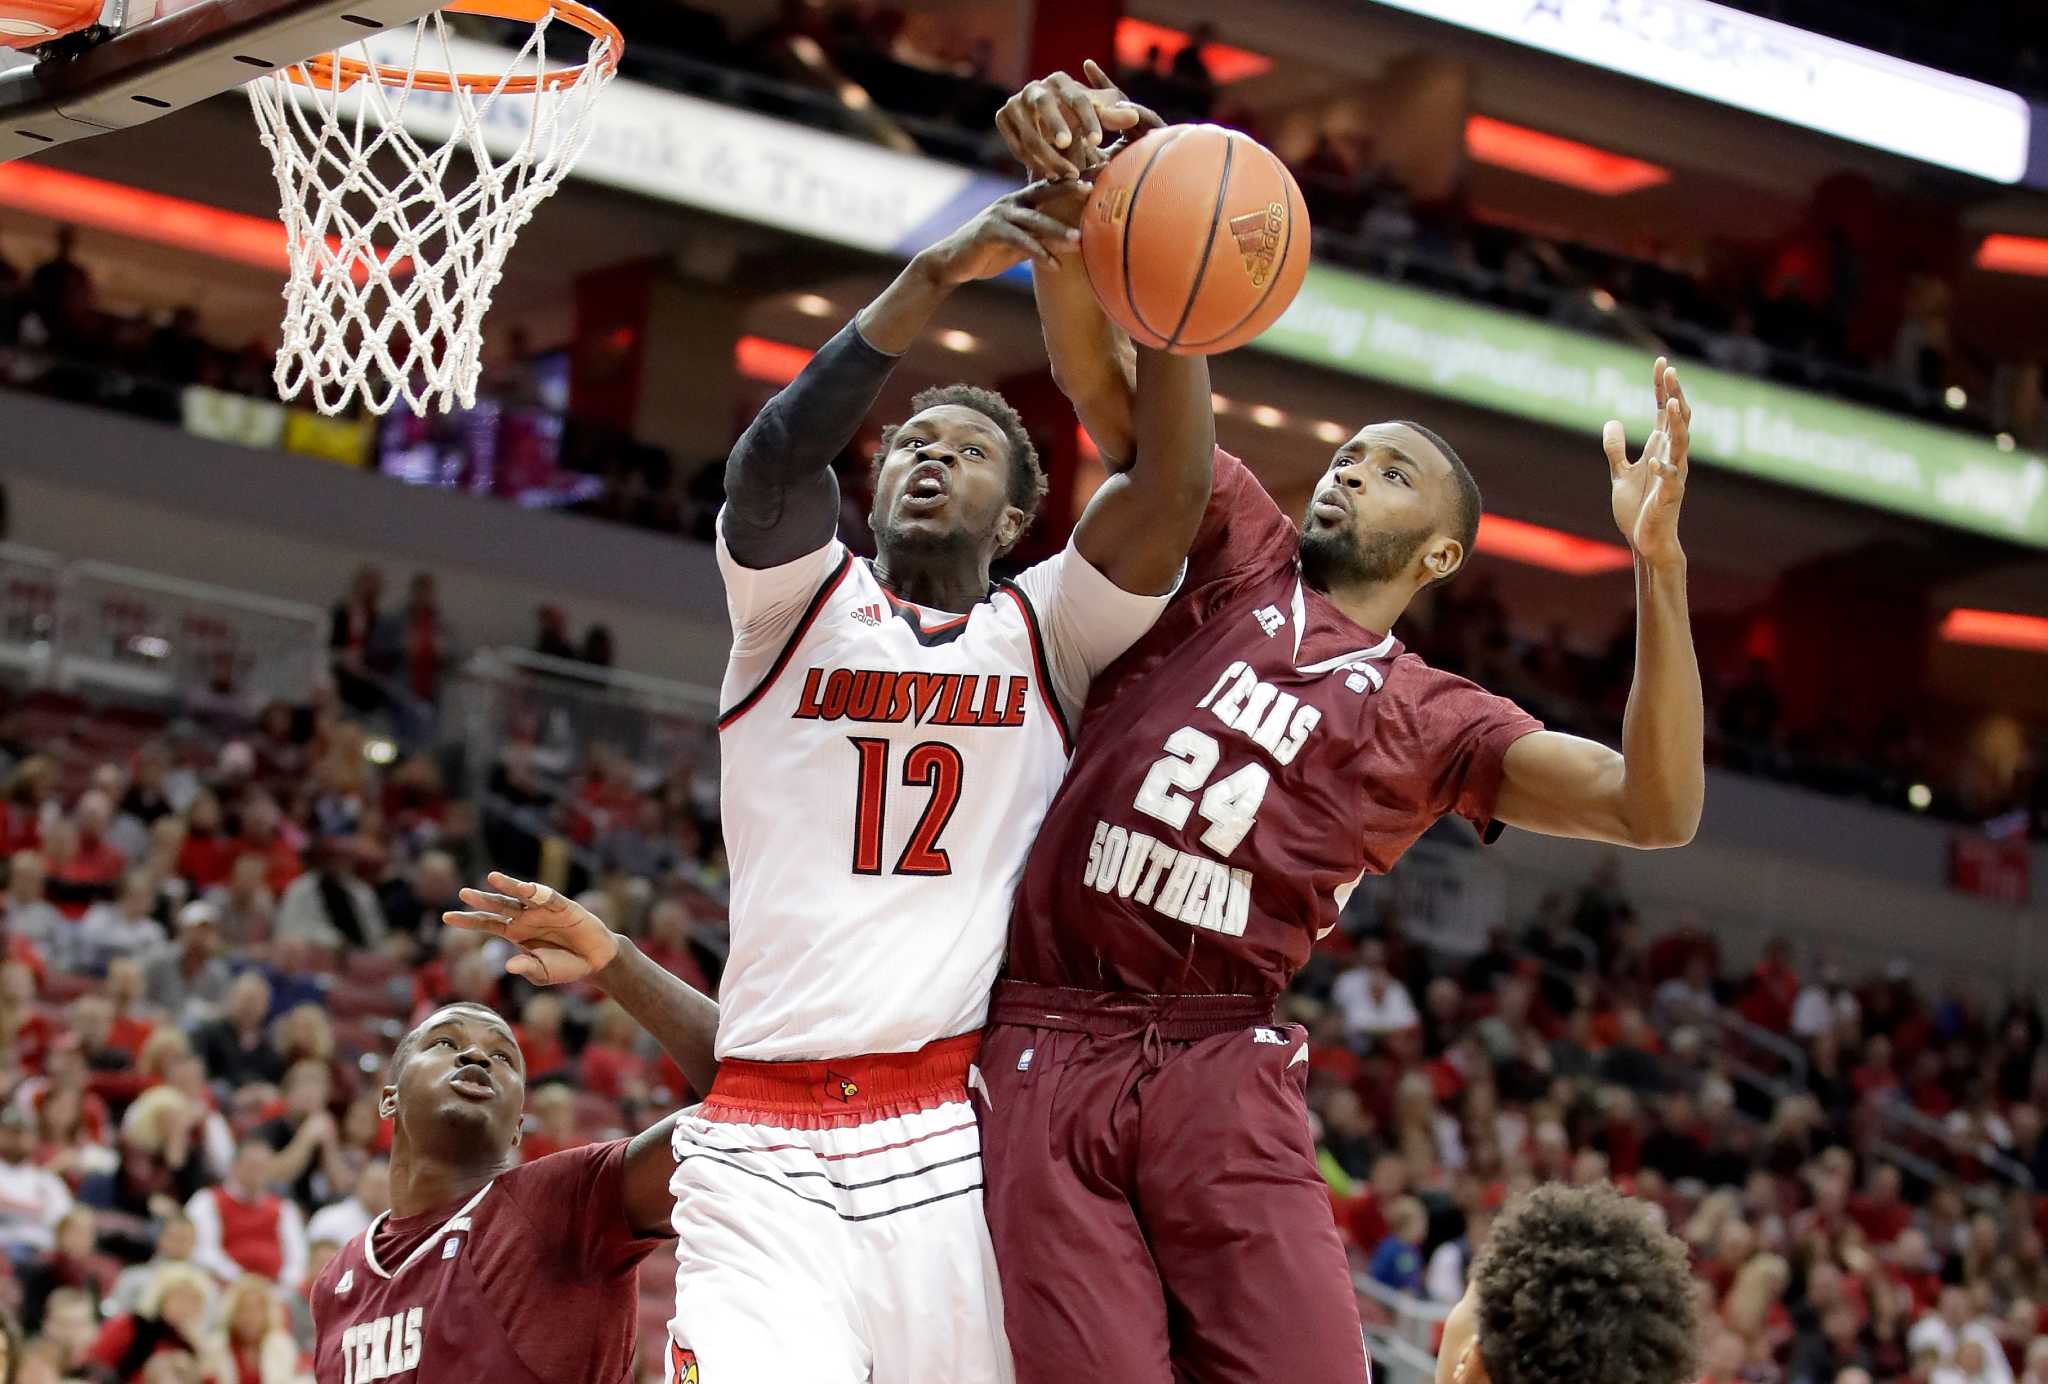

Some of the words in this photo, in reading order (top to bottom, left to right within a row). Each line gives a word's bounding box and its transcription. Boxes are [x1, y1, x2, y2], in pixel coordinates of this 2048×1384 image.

[792, 668, 1028, 728] LOUISVILLE
[847, 736, 964, 876] 12
[1133, 725, 1271, 858] 24
[1083, 820, 1254, 937] SOUTHERN
[341, 1307, 424, 1384] TEXAS
